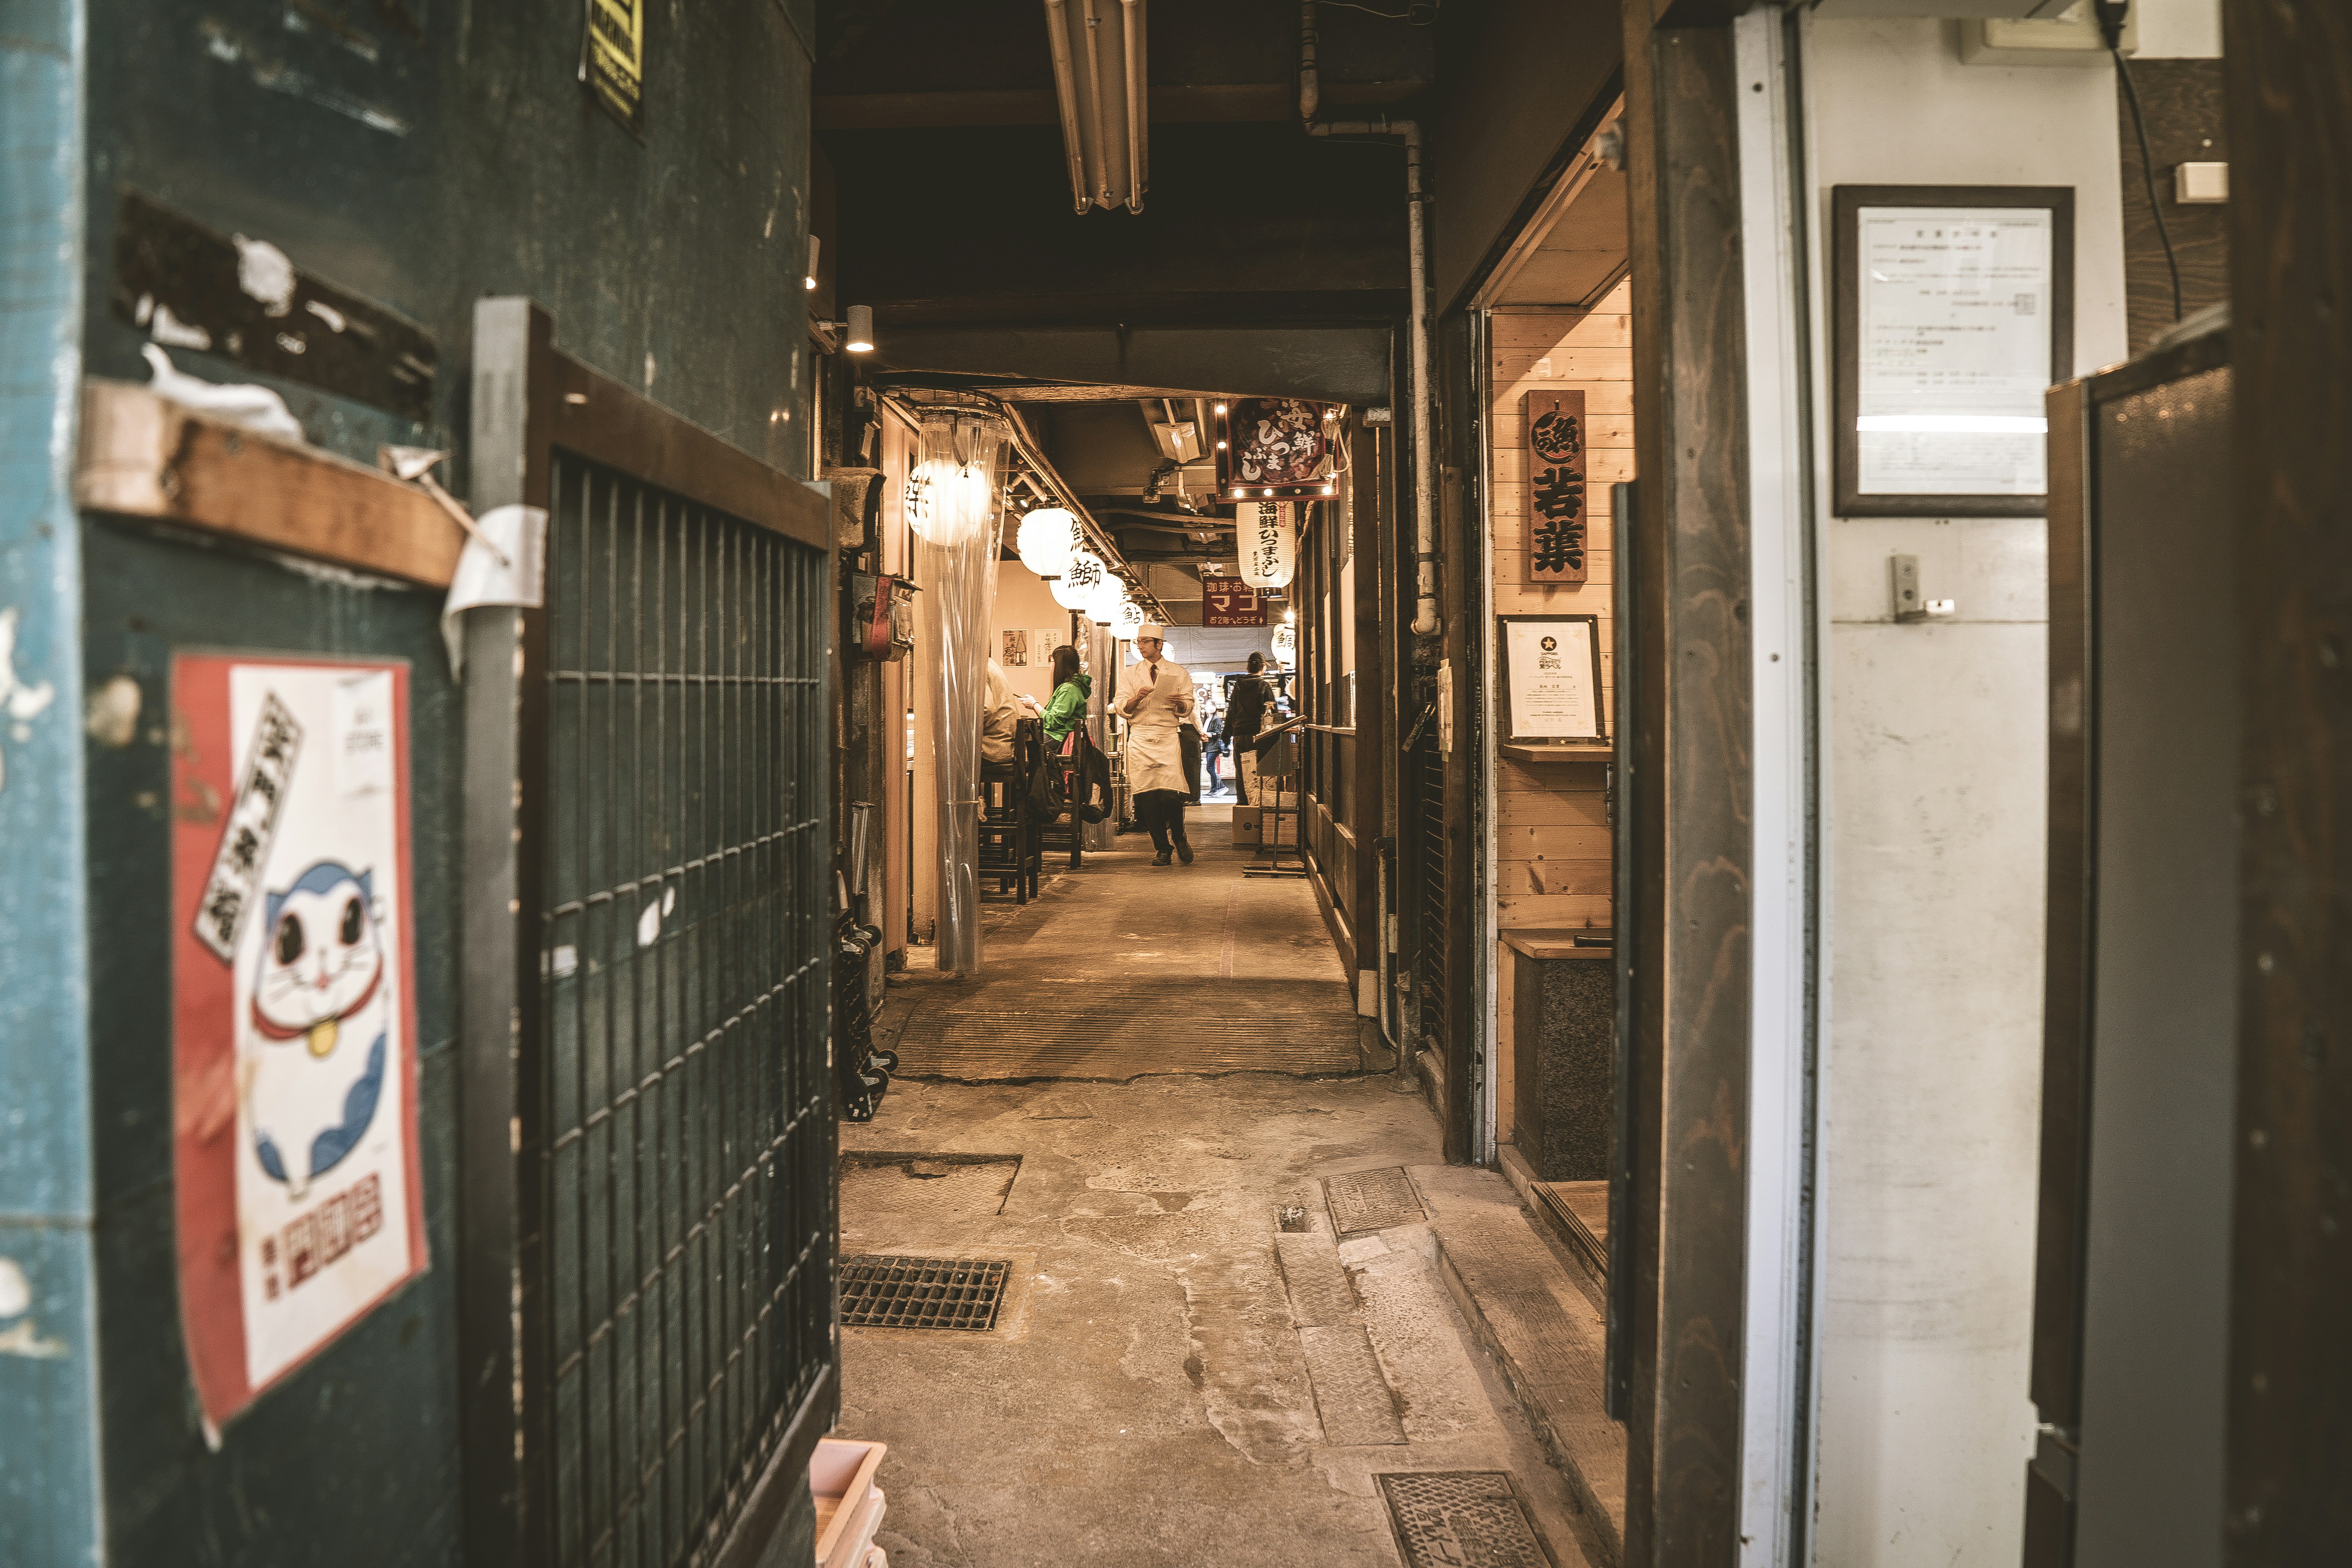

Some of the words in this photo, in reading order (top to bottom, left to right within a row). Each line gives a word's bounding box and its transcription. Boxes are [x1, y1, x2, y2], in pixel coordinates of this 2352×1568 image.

[1241, 419, 1290, 481] ひつまぶし
[1276, 399, 1317, 457] 海鮮
[1533, 467, 1584, 573] 若葉
[1211, 595, 1258, 612] マコ
